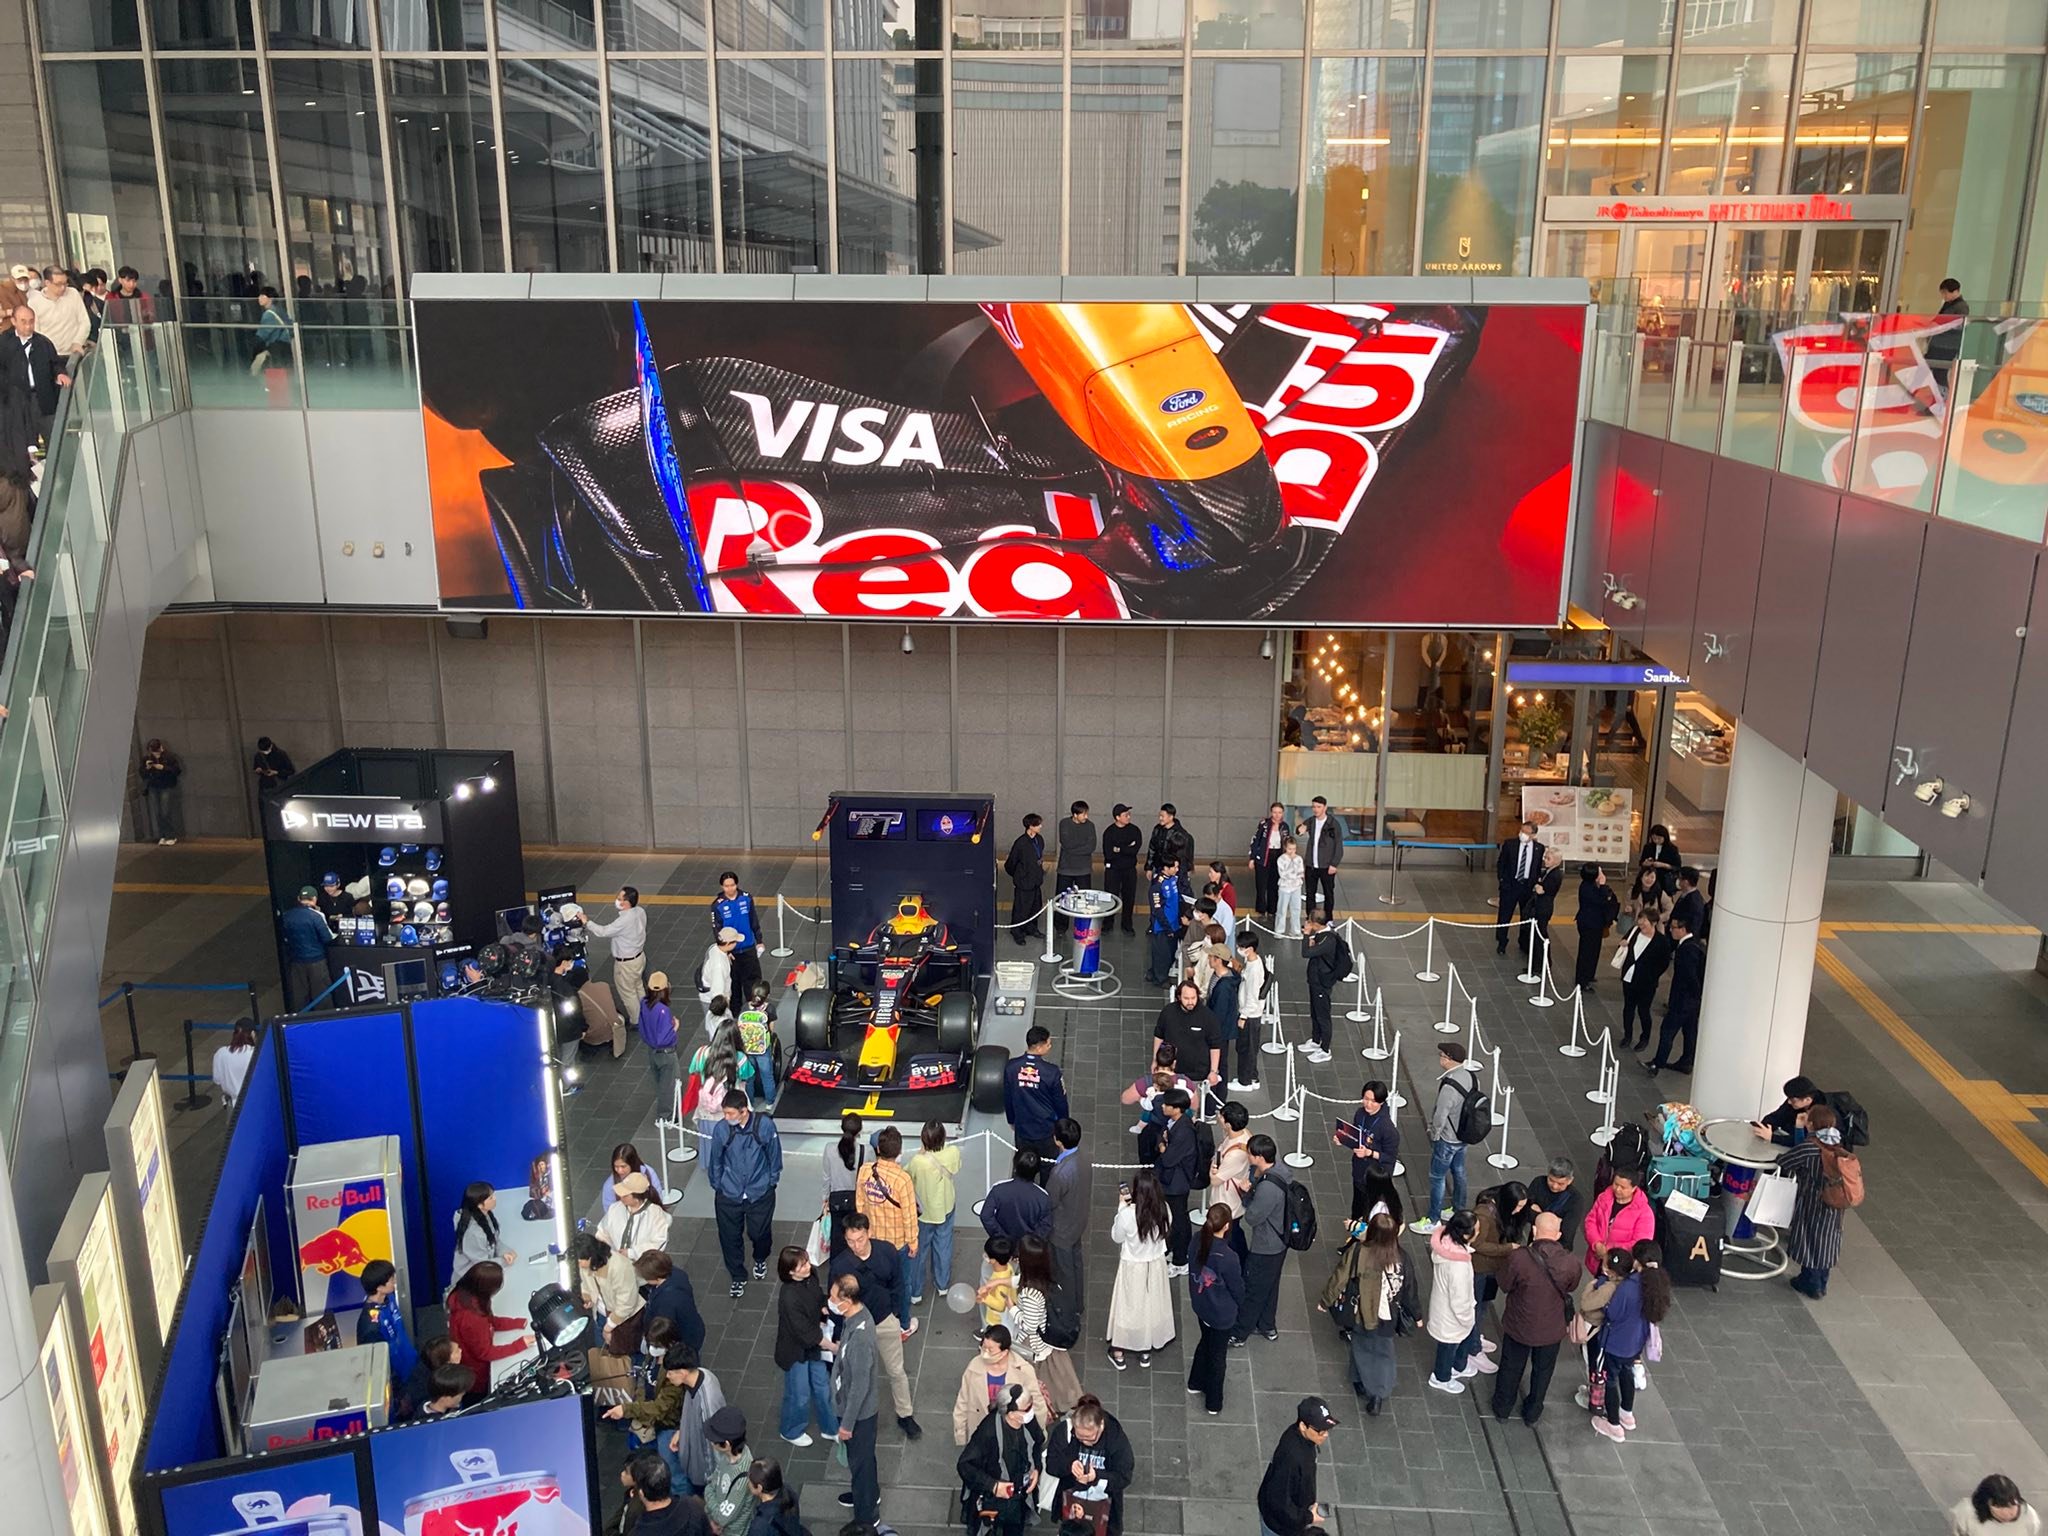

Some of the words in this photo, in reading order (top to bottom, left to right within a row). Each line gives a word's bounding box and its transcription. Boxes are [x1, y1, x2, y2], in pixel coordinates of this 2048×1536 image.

[1425, 263, 1459, 272] UNITED
[1461, 263, 1502, 272] ARROWS
[1169, 392, 1199, 412] Ford
[1166, 404, 1220, 429] RACING
[730, 391, 944, 469] VISA
[686, 480, 1134, 619] Red
[791, 1066, 843, 1088] Red
[1727, 1175, 1749, 1191] Red
[305, 1191, 342, 1211] Red
[345, 1185, 381, 1206] Bull
[1689, 1235, 1710, 1262] A
